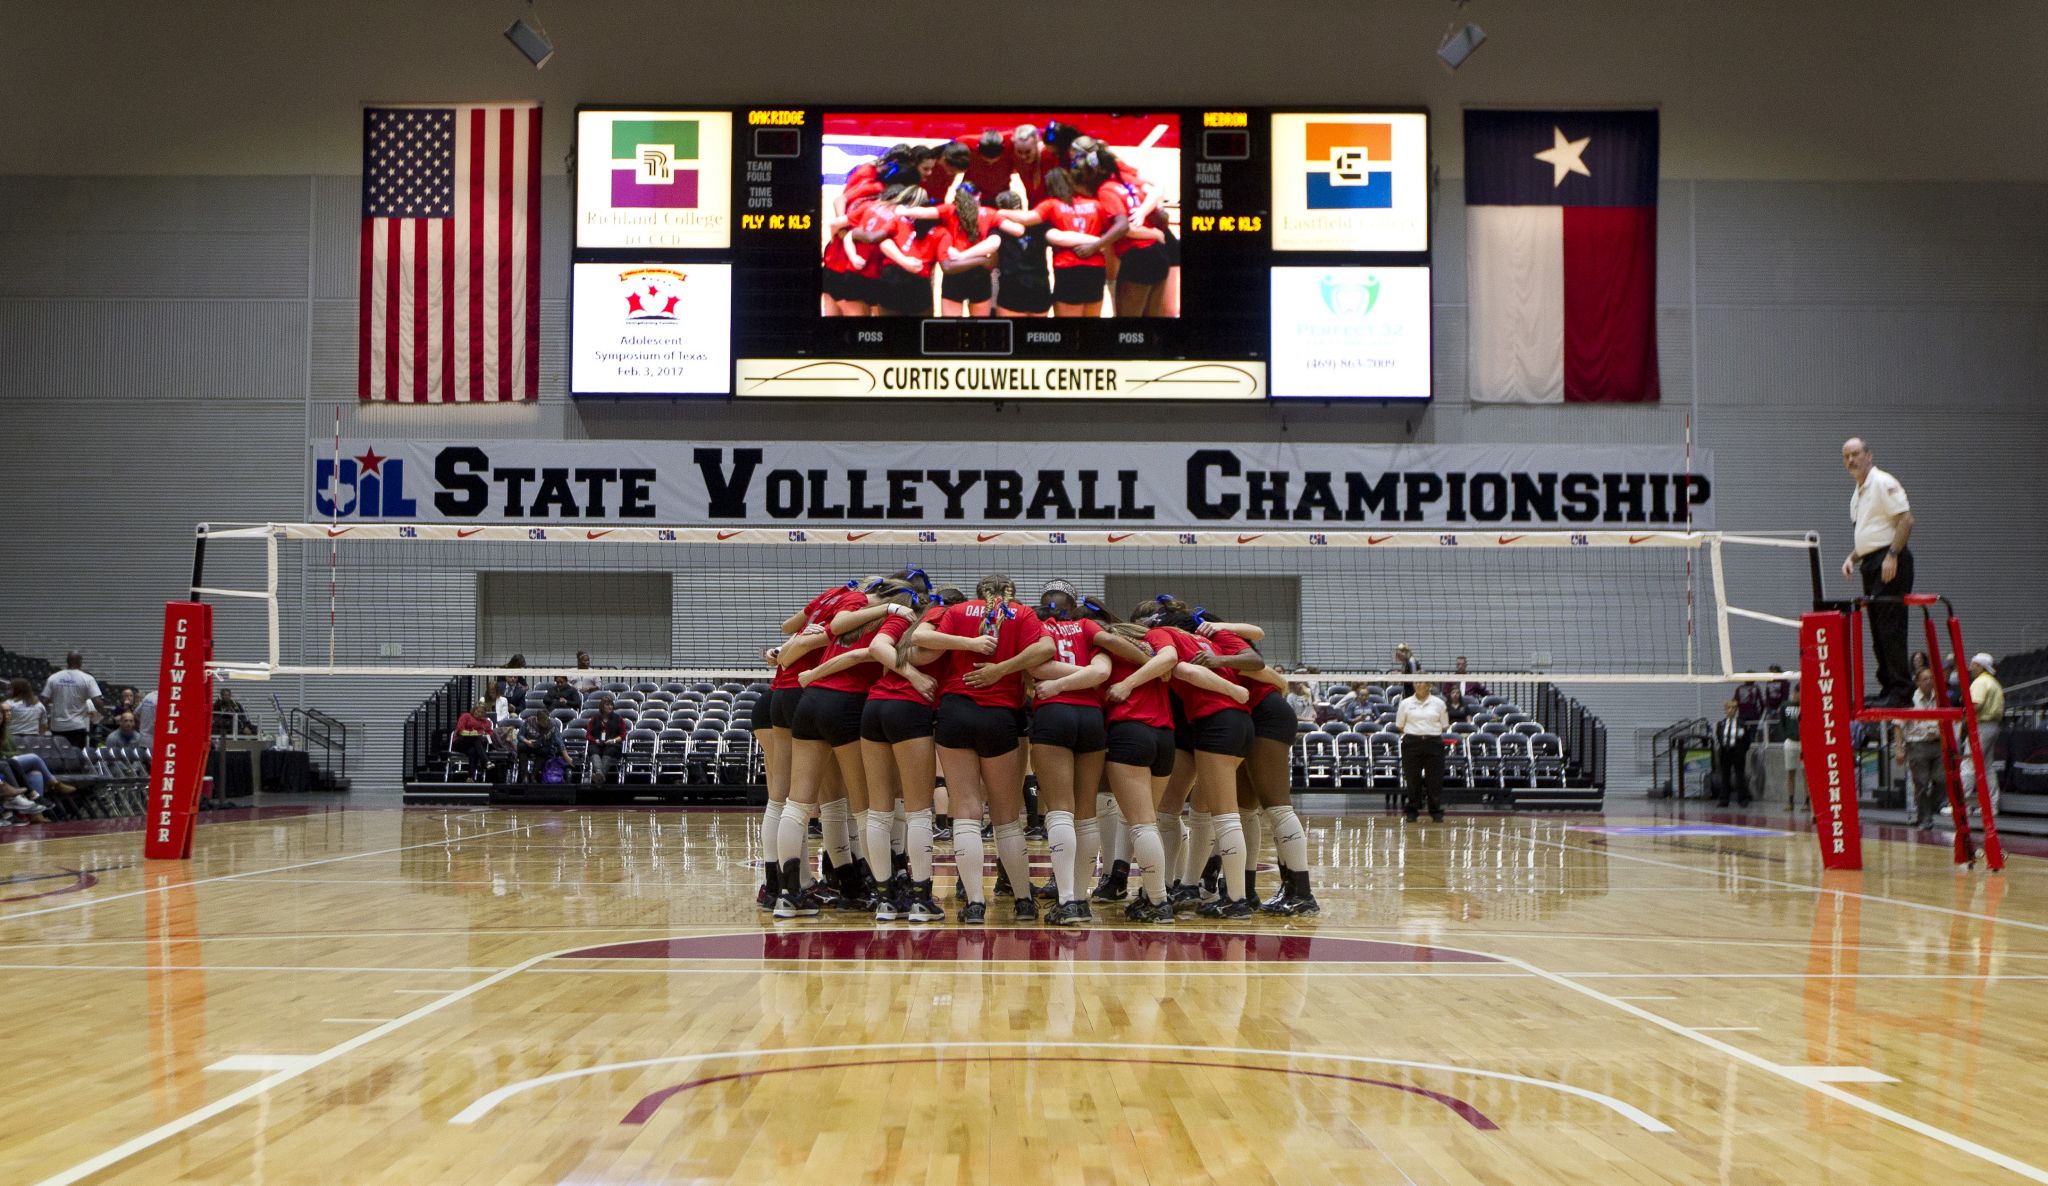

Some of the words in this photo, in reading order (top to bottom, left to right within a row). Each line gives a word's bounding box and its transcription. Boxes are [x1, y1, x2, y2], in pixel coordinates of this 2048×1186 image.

[748, 111, 805, 125] OAKRIDGE
[747, 161, 772, 171] TEAM
[1196, 163, 1222, 173] TEAM
[747, 171, 772, 182] FOULS
[1196, 173, 1221, 184] FOULS
[750, 187, 772, 197] TIME
[1199, 189, 1222, 199] TIME
[748, 197, 772, 208] OUTS
[1198, 199, 1222, 210] OUTS
[587, 211, 656, 224] Richland
[664, 212, 722, 227] College
[742, 214, 764, 229] PLY
[769, 214, 785, 229] AC
[788, 214, 811, 229] KLS
[1191, 216, 1215, 231] PLY
[620, 336, 682, 345] Adolescent
[858, 332, 883, 342] POSS
[1027, 332, 1061, 343] PERIOD
[1119, 332, 1144, 343] POSS
[595, 351, 661, 362] Symposium
[663, 351, 675, 360] of
[679, 351, 708, 360] Texas
[618, 366, 641, 376] Feb.
[645, 367, 654, 377] 3,
[657, 366, 684, 376] 2017
[883, 367, 949, 390] CURTIS
[955, 367, 1040, 390] CULWELL
[1045, 368, 1117, 391] CENTER
[1058, 639, 1076, 666] 5
[167, 619, 188, 734] CULWELL
[1816, 628, 1836, 746] CULWELL
[1827, 753, 1845, 854] CENTER
[158, 743, 177, 843] CENTER
